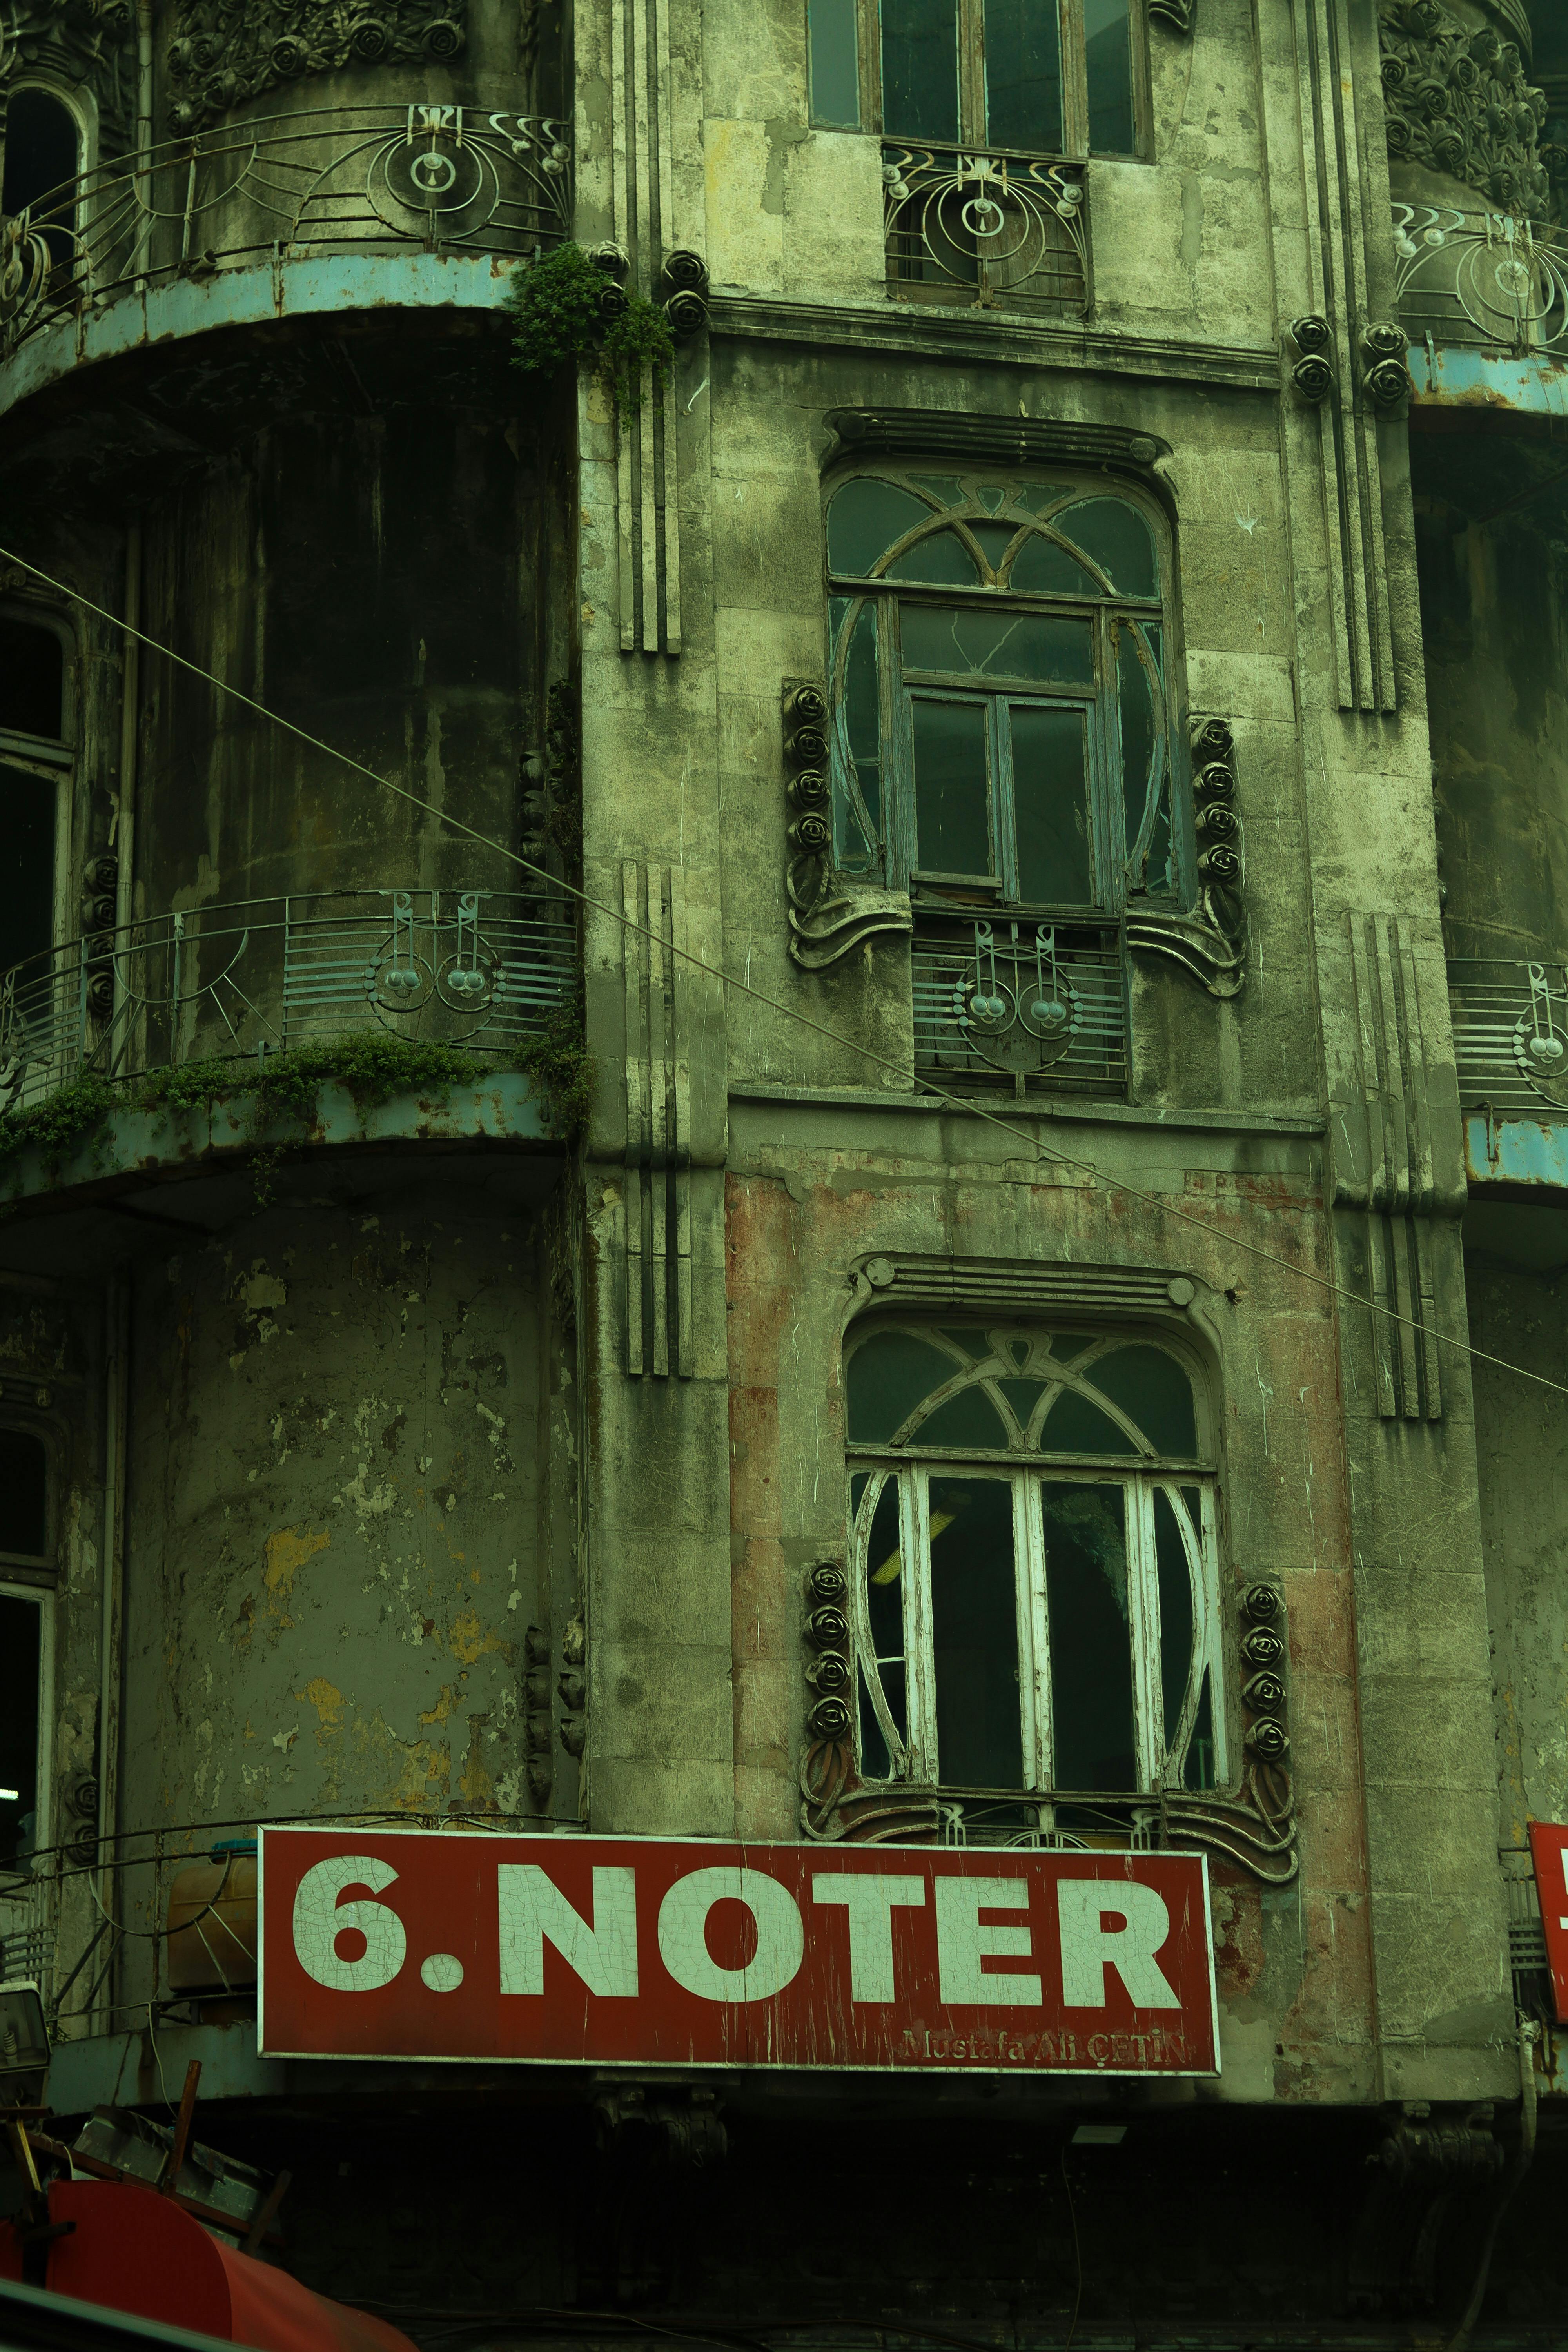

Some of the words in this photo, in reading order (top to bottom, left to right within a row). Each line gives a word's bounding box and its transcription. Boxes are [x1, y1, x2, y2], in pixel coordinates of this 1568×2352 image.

[292, 1855, 464, 1993] 6.
[498, 1864, 1183, 2009] NOTER
[902, 2029, 1026, 2060] Mustafa
[1034, 2032, 1078, 2061] Ali
[1087, 2028, 1185, 2068] ÇETİN
